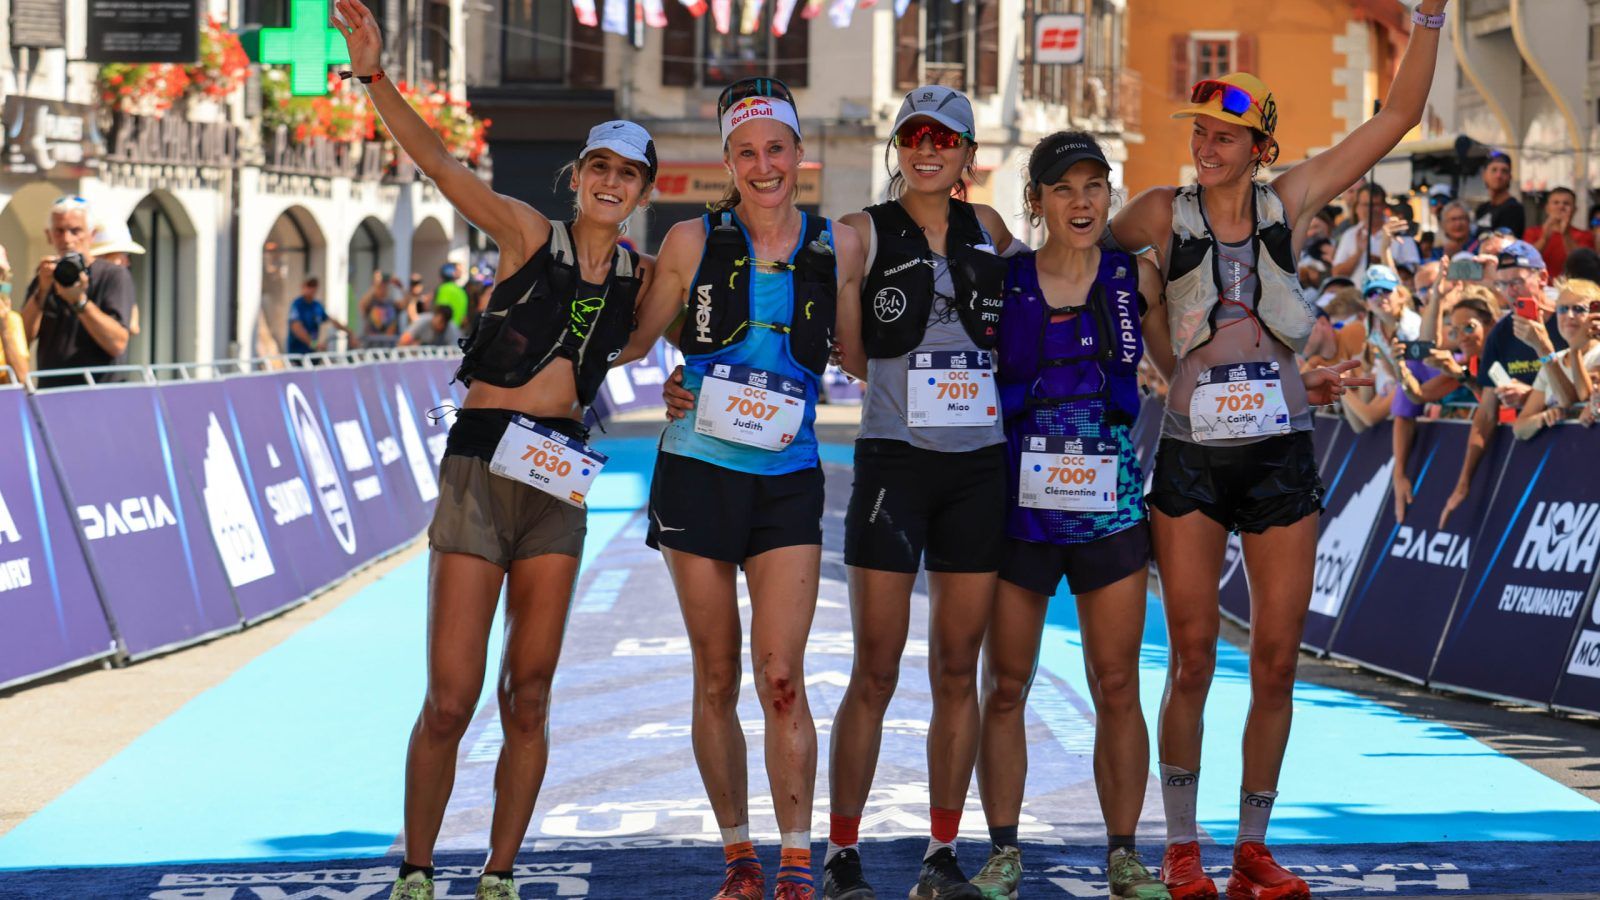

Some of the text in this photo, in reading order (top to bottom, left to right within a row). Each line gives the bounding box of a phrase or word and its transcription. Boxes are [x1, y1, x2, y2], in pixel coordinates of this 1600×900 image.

[731, 107, 773, 126] Red Bull
[1056, 143, 1088, 155] KIPRUN
[884, 257, 921, 277] SALOMON
[1233, 261, 1241, 301] SALOMON
[696, 284, 713, 343] HOKA
[1117, 290, 1136, 363] KIPRUN
[949, 371, 969, 380] OCC
[744, 387, 767, 400] OCC
[936, 383, 979, 400] 7019
[1228, 383, 1250, 393] OCC
[725, 395, 779, 421] 7007
[947, 403, 970, 411] Miao
[1215, 393, 1264, 413] 7029
[733, 418, 763, 432] Judith
[1227, 413, 1257, 423] Caitlin
[543, 440, 566, 455] OCC
[521, 445, 571, 477] 7030
[1062, 456, 1085, 465] OCC
[529, 469, 550, 484] Sara
[1046, 466, 1096, 485] 7009
[1045, 486, 1096, 496] Clémentine
[77, 495, 178, 540] DACIA
[1512, 501, 1600, 573] HOKA
[1391, 526, 1471, 569] DACIA
[1498, 584, 1522, 611] FLY
[1515, 586, 1564, 616] HUMAN
[1557, 589, 1584, 618] FLY
